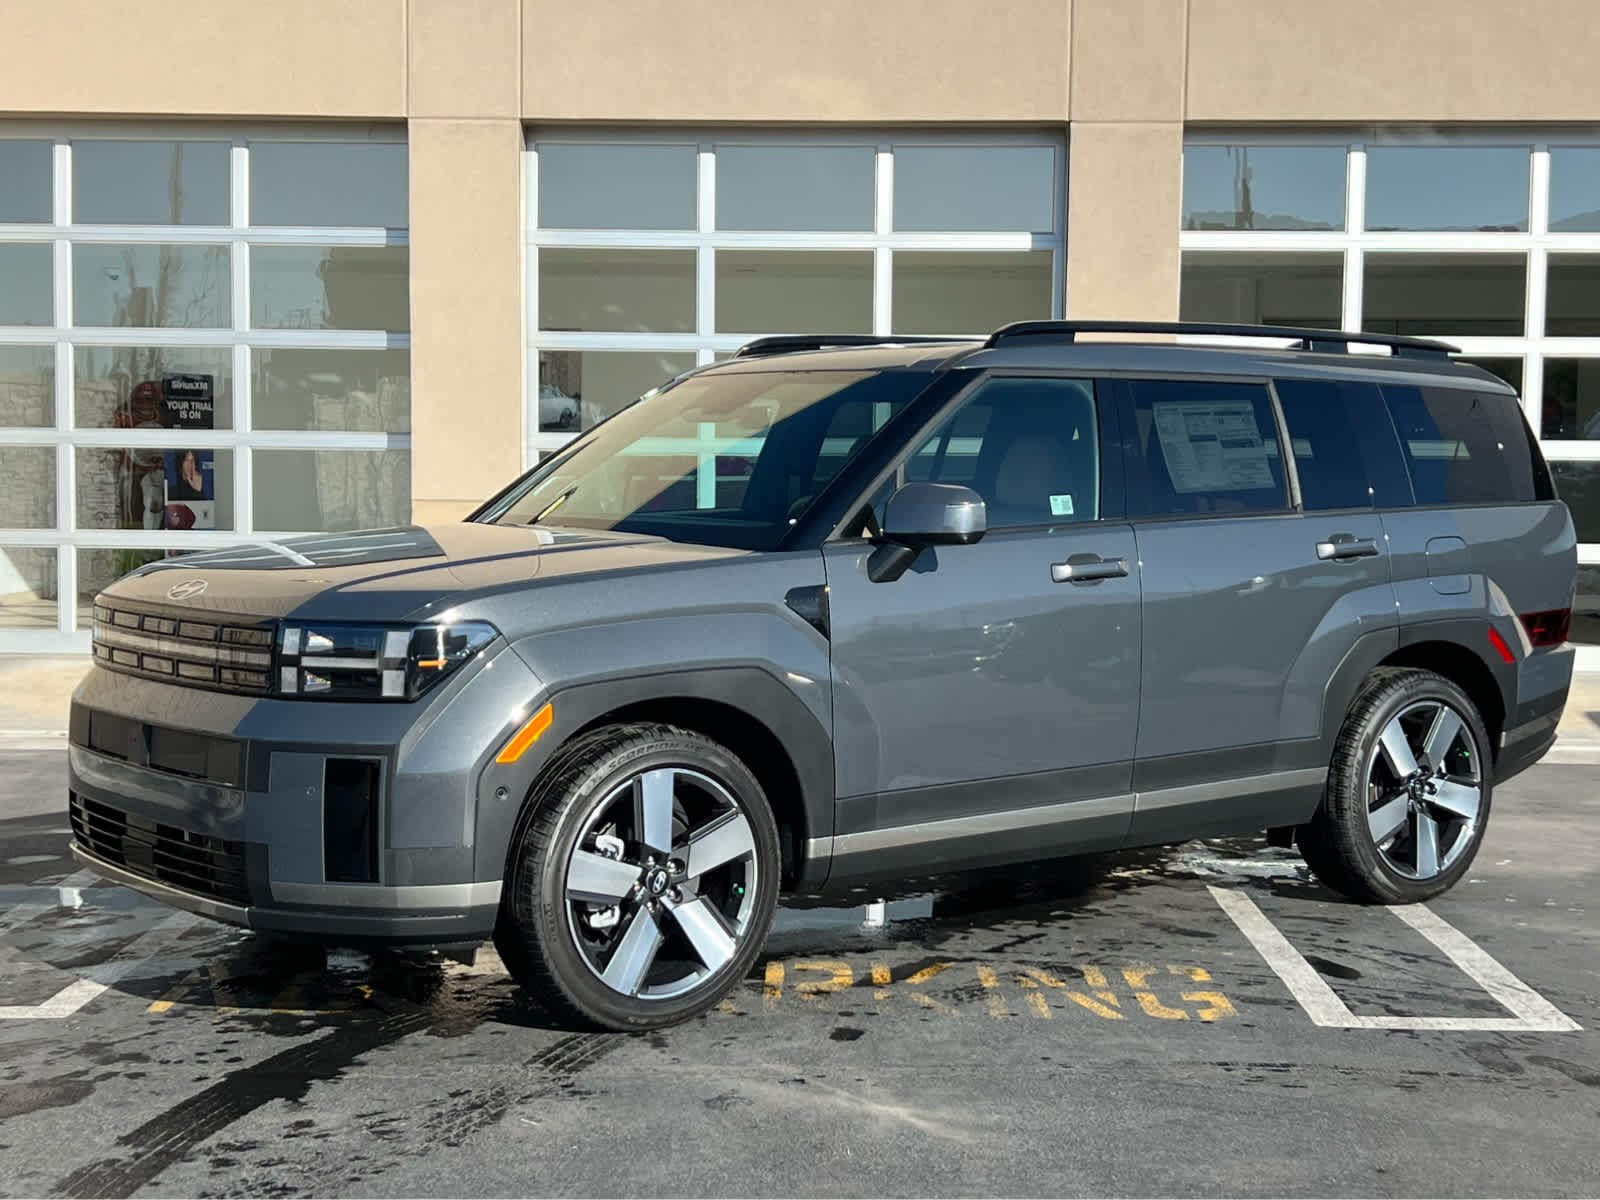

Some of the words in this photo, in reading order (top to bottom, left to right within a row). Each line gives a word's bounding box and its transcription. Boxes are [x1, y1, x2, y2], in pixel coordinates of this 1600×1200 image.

[167, 400, 189, 410] YOUR
[190, 401, 212, 411] TRIAL
[179, 410, 188, 419] IS
[189, 410, 201, 419] ON
